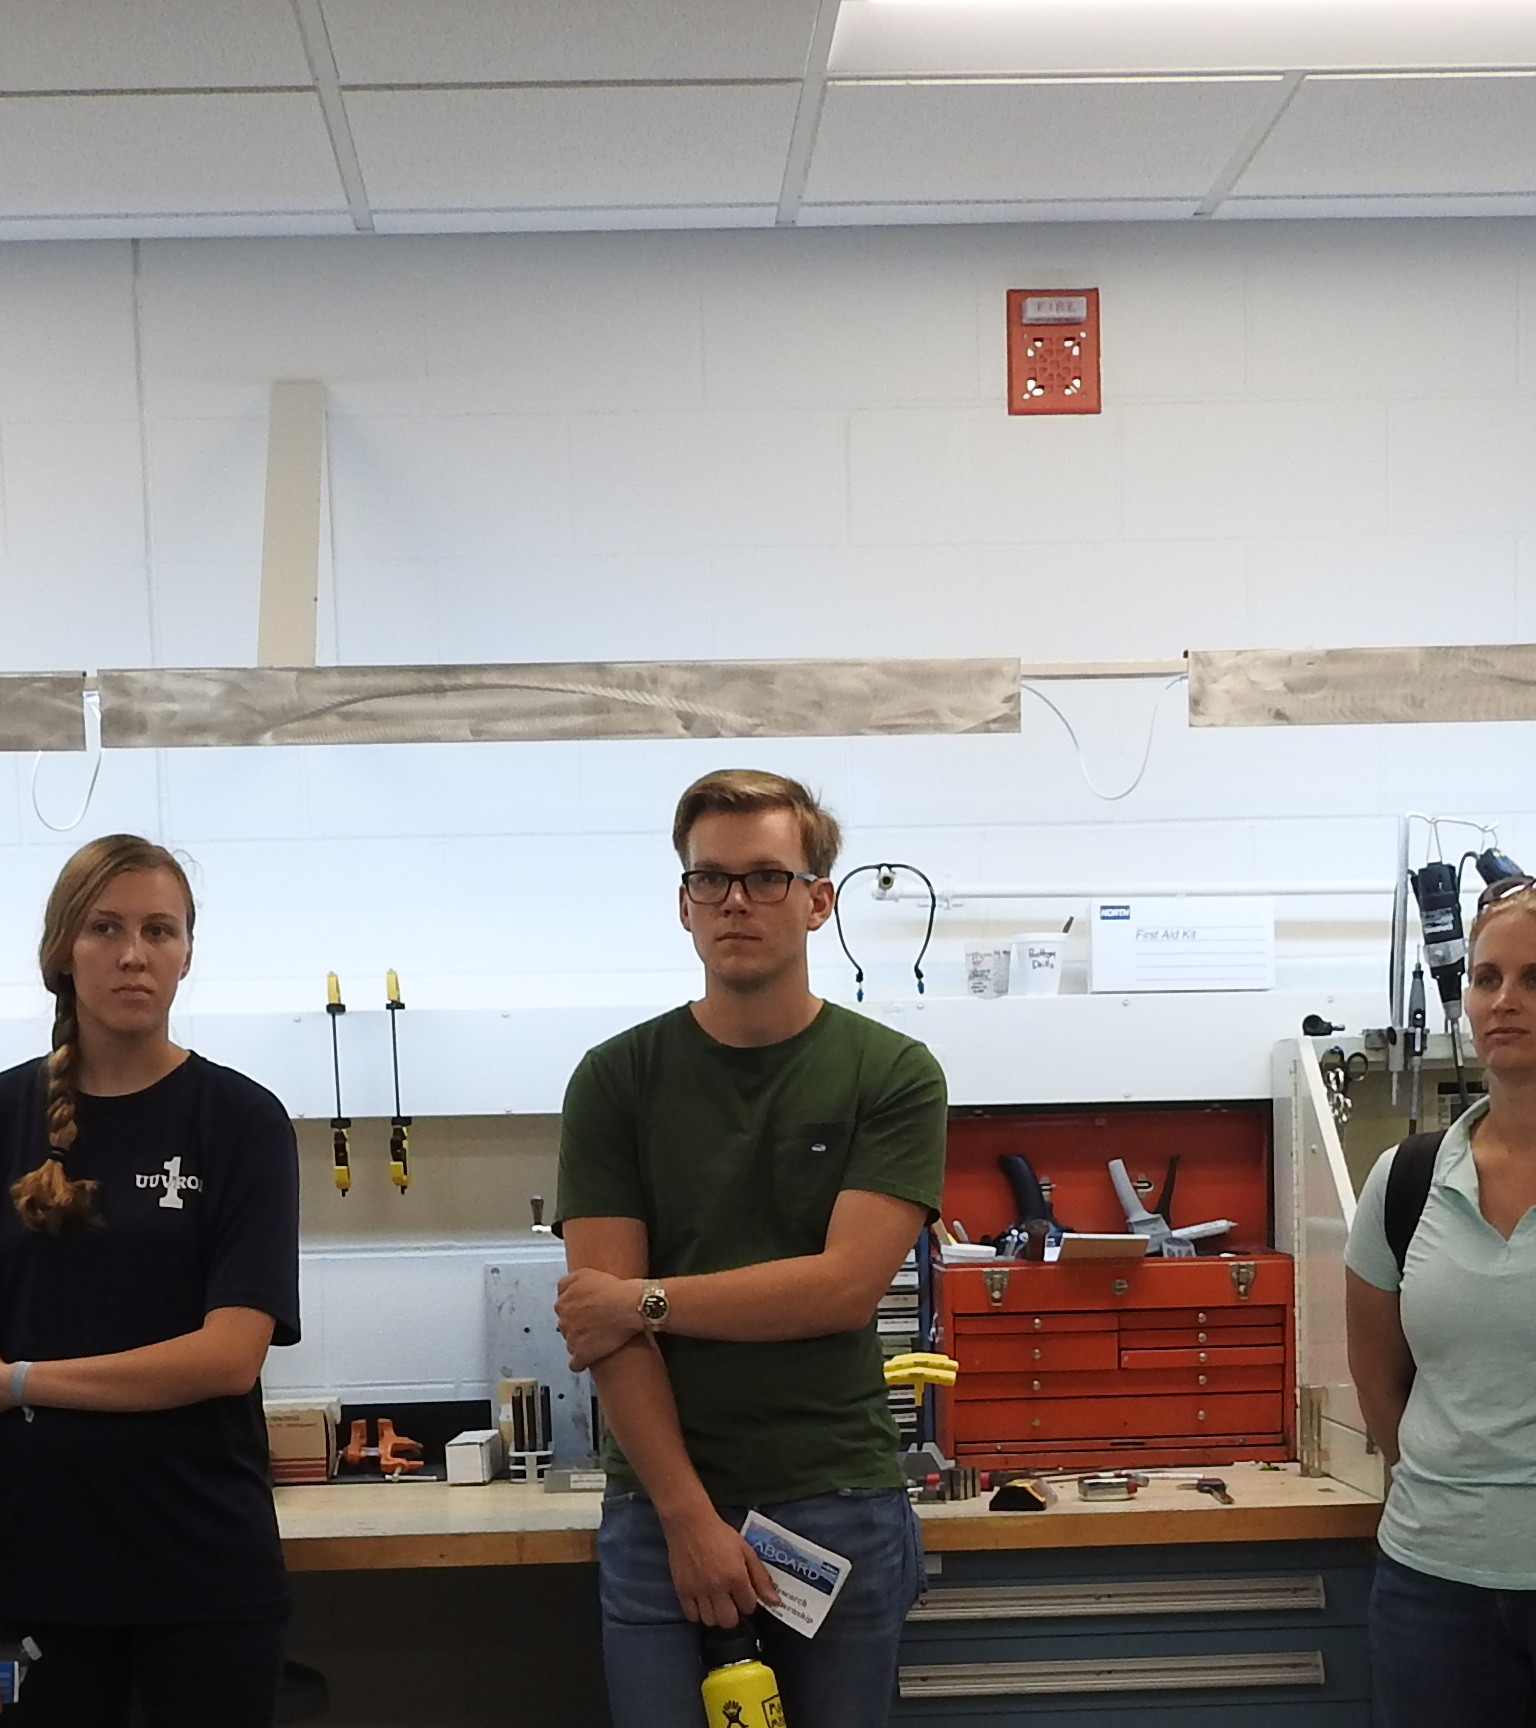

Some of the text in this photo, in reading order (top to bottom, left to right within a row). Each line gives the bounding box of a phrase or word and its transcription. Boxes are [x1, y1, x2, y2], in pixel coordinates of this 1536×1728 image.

[1036, 301, 1077, 313] FIRE
[1135, 929, 1197, 940] First Aid Kit
[753, 1541, 820, 1581] ABOARD
